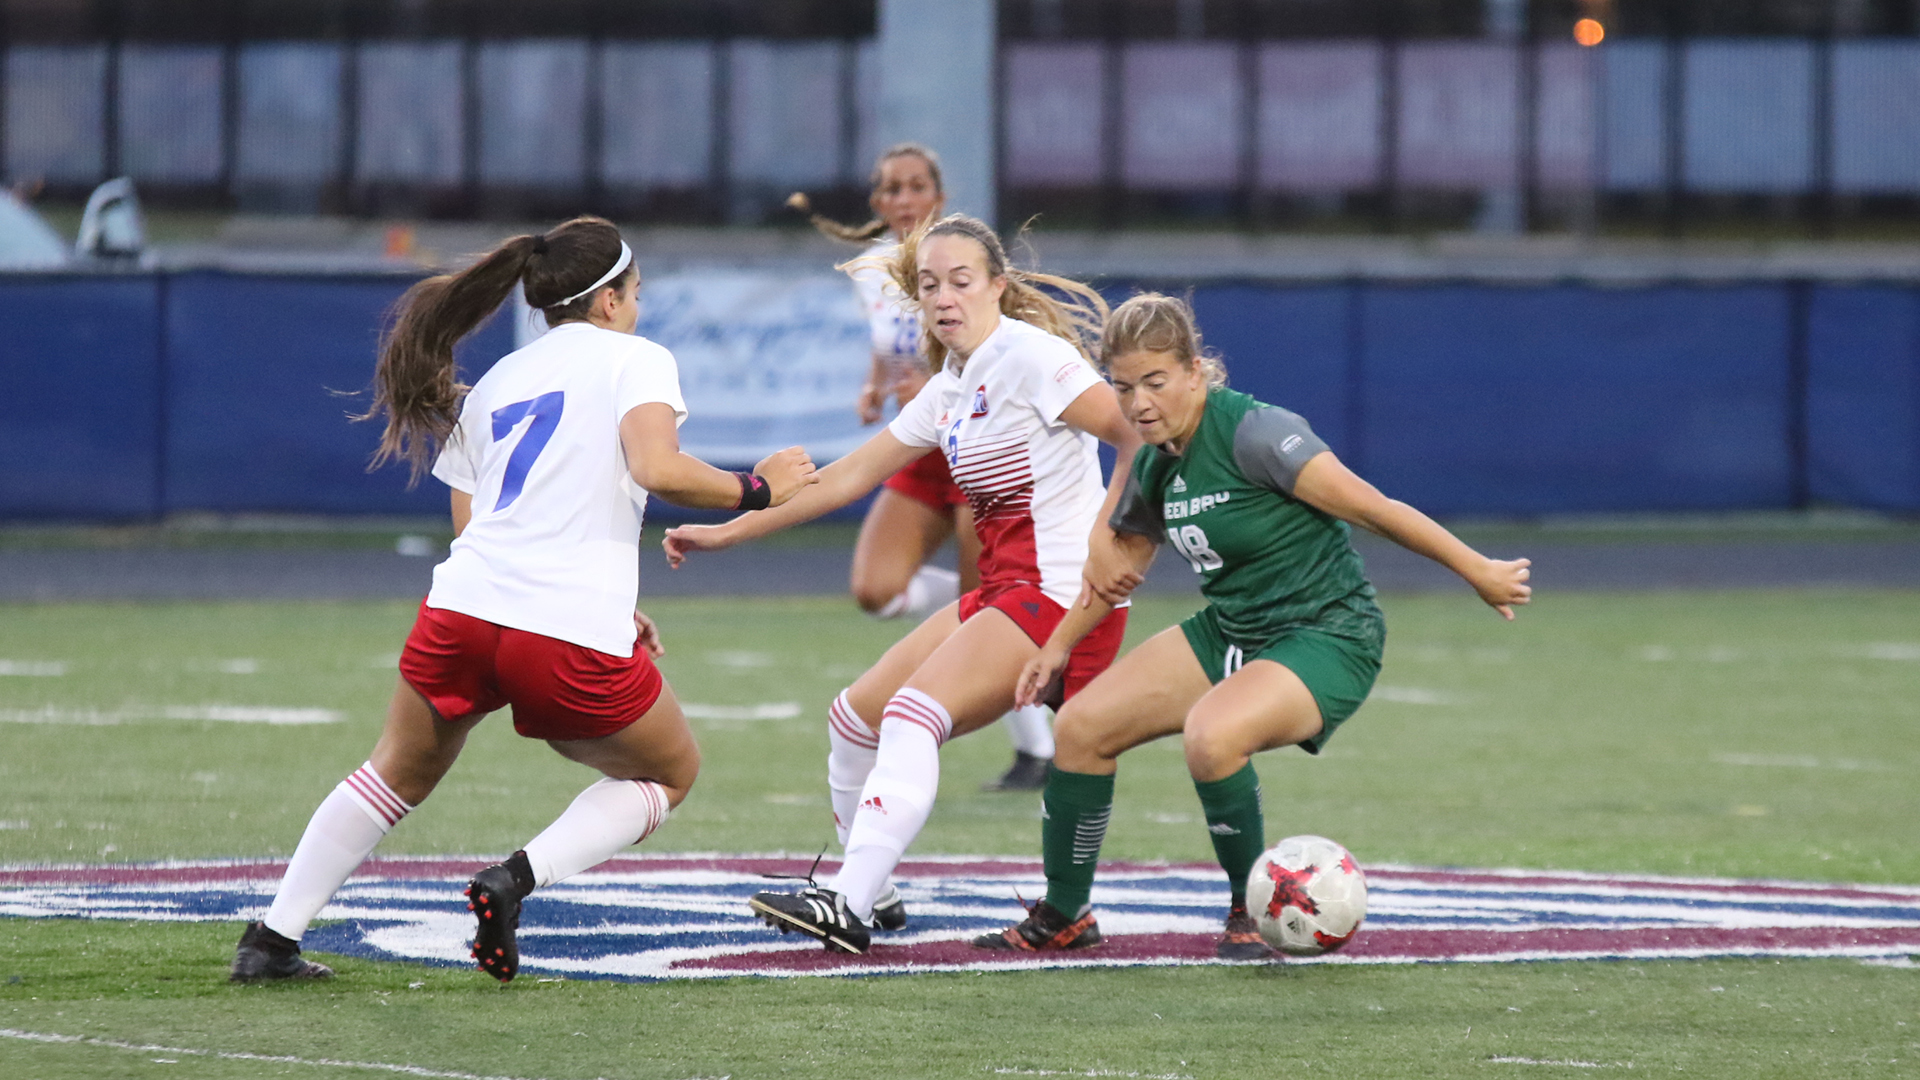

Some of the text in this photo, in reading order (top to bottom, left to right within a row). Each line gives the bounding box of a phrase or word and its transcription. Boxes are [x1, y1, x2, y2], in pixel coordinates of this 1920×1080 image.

[491, 391, 564, 514] 7
[1164, 500, 1188, 519] EEN
[1168, 524, 1223, 574] 18
